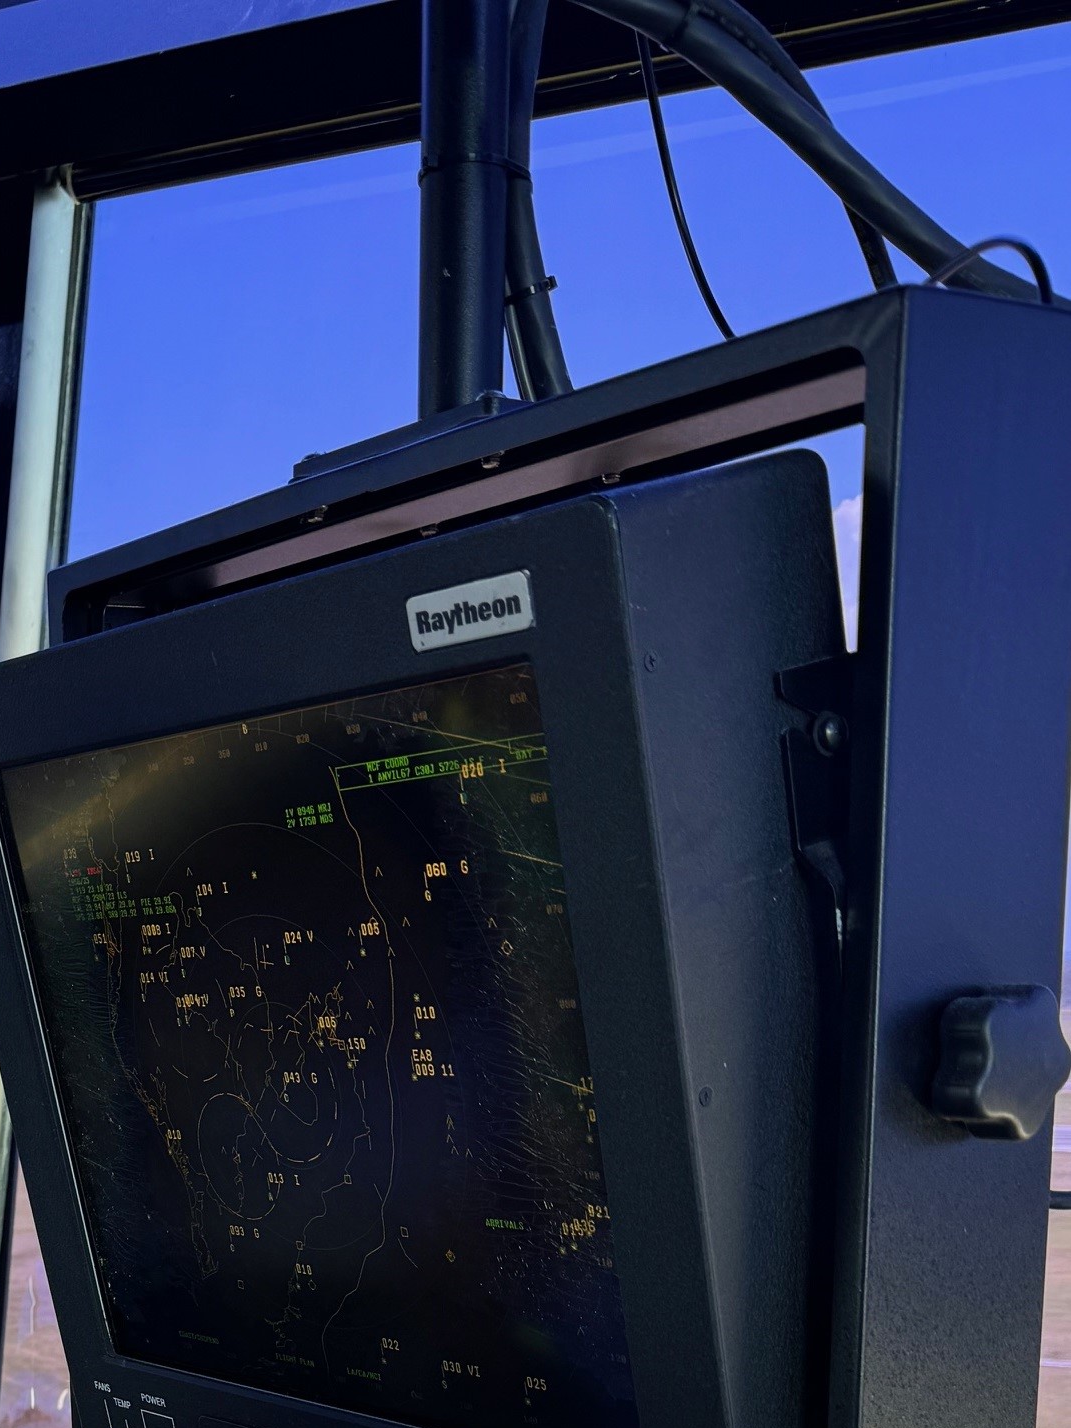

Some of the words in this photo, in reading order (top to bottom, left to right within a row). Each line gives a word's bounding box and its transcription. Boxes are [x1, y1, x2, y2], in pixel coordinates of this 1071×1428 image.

[416, 594, 521, 634] Raytheon
[378, 766, 410, 783] ANVIL67
[415, 763, 434, 776] C30J
[461, 762, 484, 779] 020
[299, 816, 317, 827] 1750
[126, 851, 140, 863] 019
[426, 862, 447, 878] 060
[461, 860, 469, 874] G
[197, 883, 213, 896] 104
[361, 922, 379, 936] 005
[284, 931, 302, 944] 024
[307, 930, 314, 942] V
[141, 973, 155, 983] 014
[229, 986, 245, 998] 035
[256, 986, 262, 997] G
[416, 1006, 436, 1019] 010
[348, 1038, 366, 1050] 150
[412, 1049, 432, 1062] EA8
[414, 1064, 434, 1076] 009
[283, 1073, 300, 1083] 043
[268, 1173, 284, 1184] 013
[485, 1218, 524, 1231] ARRIVALS
[230, 1226, 244, 1237] 093
[381, 1337, 400, 1352] 022
[443, 1360, 461, 1373] 030
[94, 1381, 111, 1392] FANS
[526, 1376, 546, 1391] 025
[113, 1397, 131, 1409] TEMP
[141, 1393, 166, 1408] POWER
